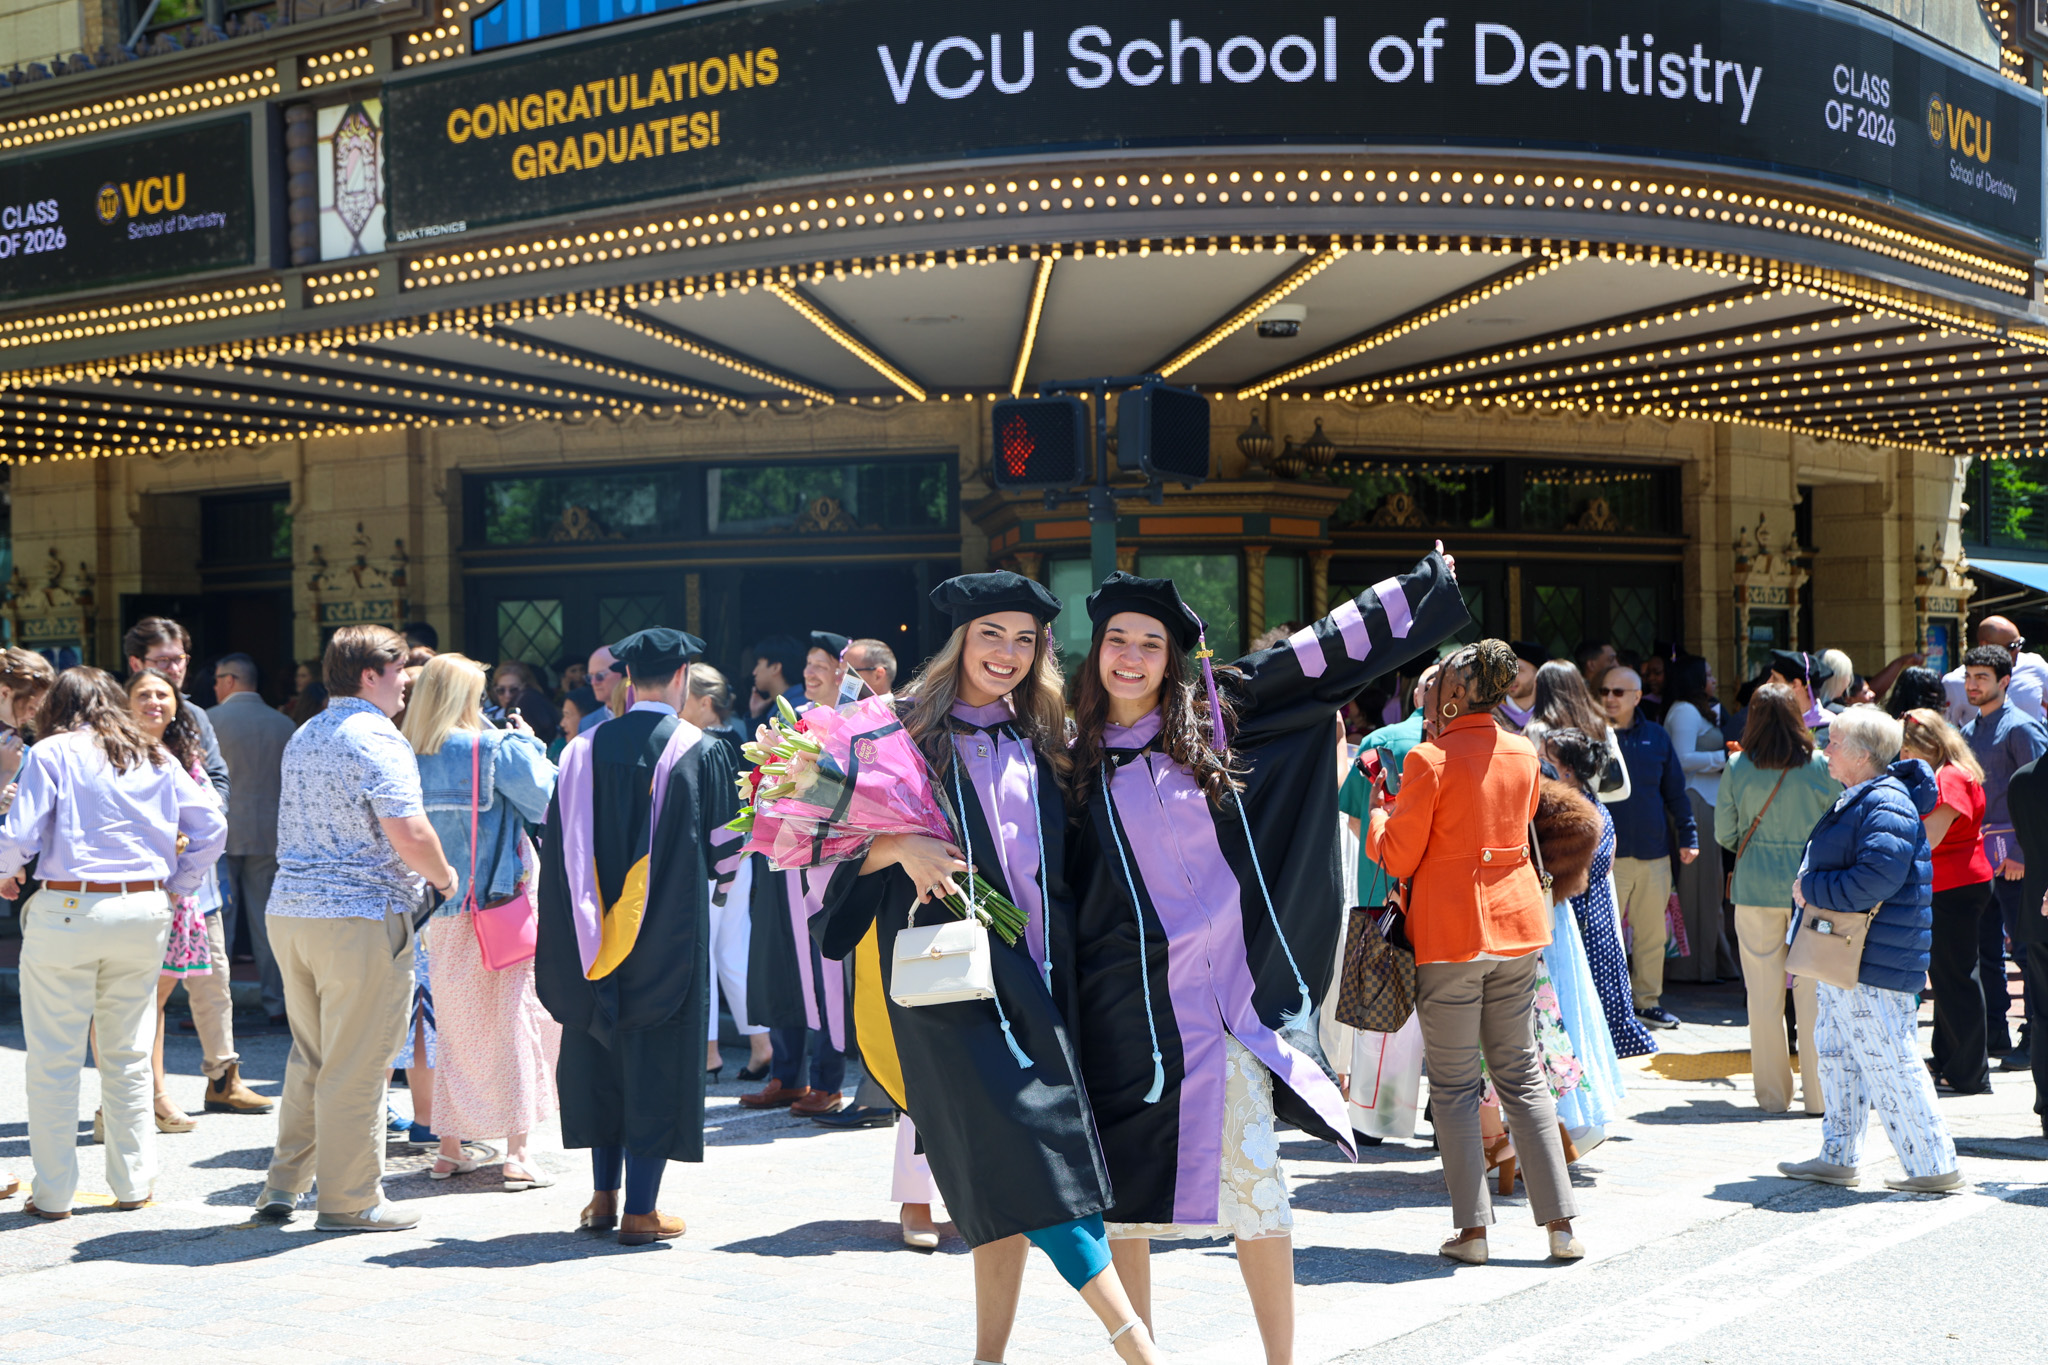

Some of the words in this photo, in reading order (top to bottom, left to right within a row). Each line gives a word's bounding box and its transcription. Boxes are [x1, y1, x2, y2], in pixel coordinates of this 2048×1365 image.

[877, 31, 1034, 104] VCU
[1067, 16, 1337, 88] School
[1369, 17, 1447, 83] of
[1475, 22, 1763, 124] Dentistry
[1833, 64, 1890, 109] CLASS
[446, 46, 779, 144] CONGRATULATIONS
[511, 111, 720, 181] GRADUATES!
[1825, 99, 1854, 133] OF
[1857, 107, 1897, 148] 2026
[1946, 103, 1992, 163] VCU
[120, 172, 187, 218] VCU
[1950, 157, 1975, 186] School
[1975, 169, 1984, 189] of
[1985, 171, 2017, 205] Dentistry
[2, 199, 60, 231] CLASS
[127, 219, 164, 240] School
[164, 215, 177, 234] of
[177, 211, 227, 232] Dentistry
[396, 220, 467, 242] DAKTRONICS
[23, 225, 67, 255] 2026
